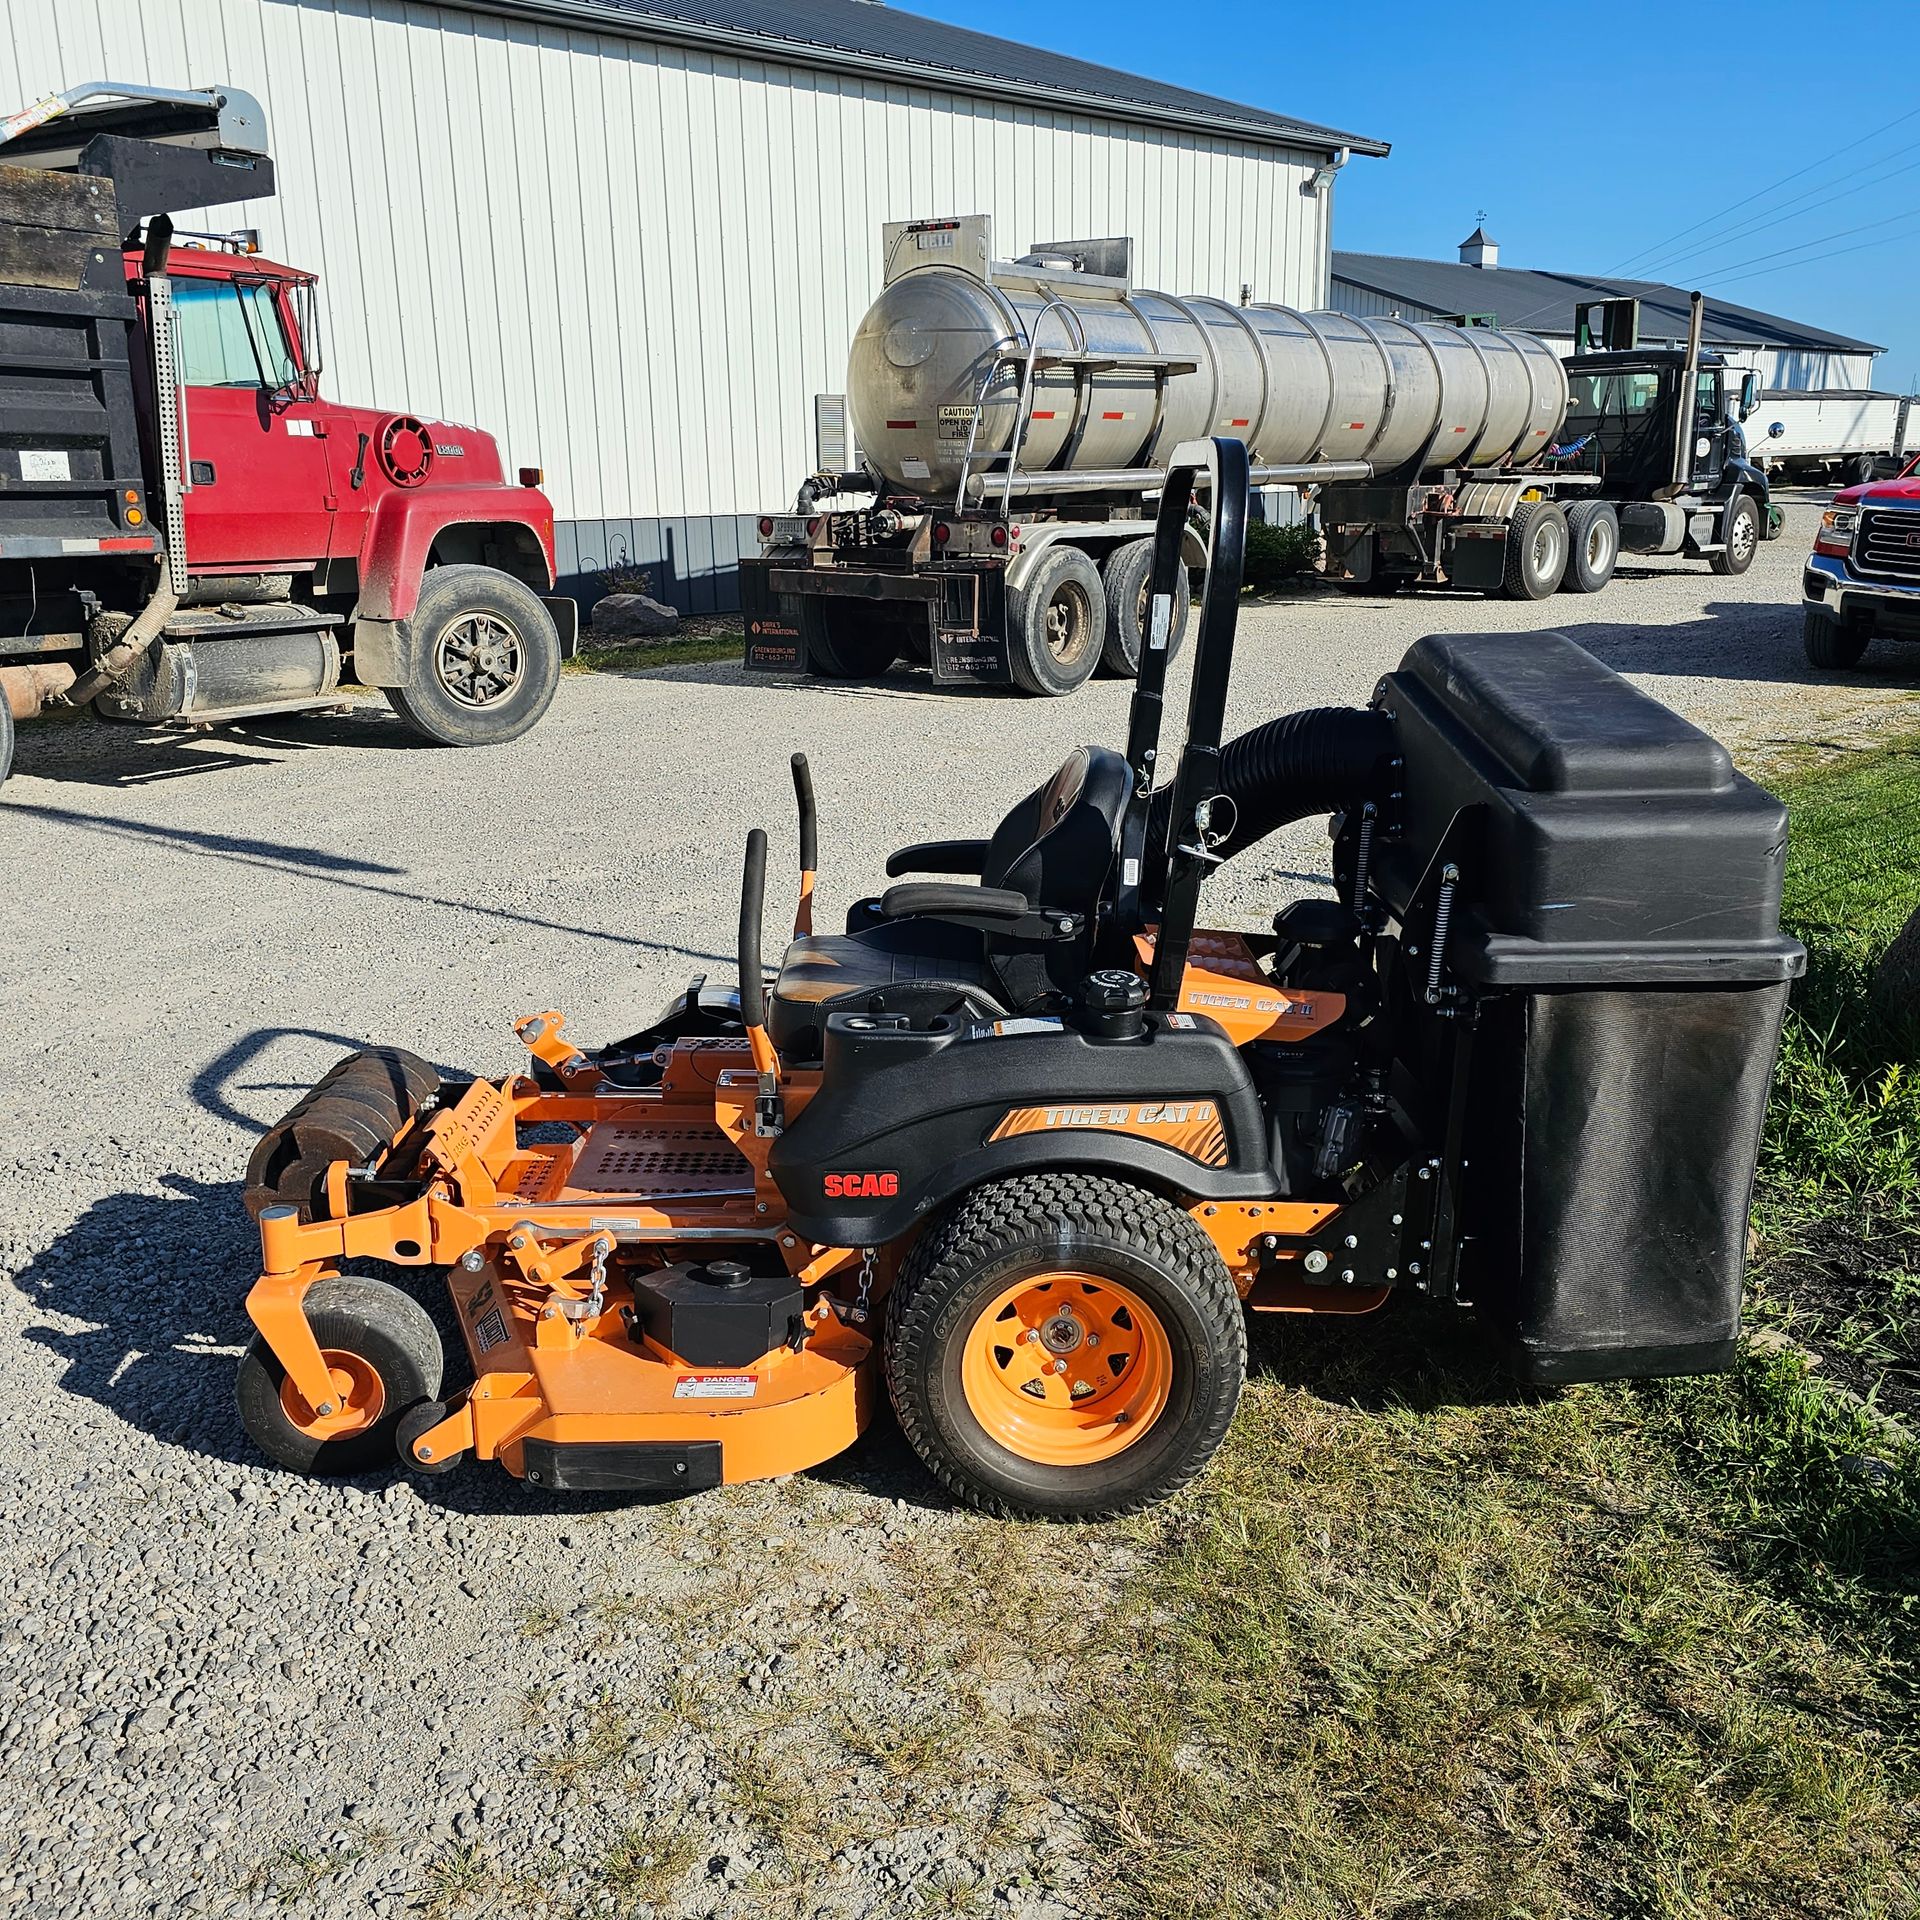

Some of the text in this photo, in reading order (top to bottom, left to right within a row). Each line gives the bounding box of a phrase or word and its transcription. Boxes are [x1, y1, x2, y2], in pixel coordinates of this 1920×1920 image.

[943, 408, 975, 416] CAUTION
[1188, 992, 1251, 1009] TIGER
[1256, 999, 1298, 1014] CAT
[1044, 1104, 1212, 1125] TIGER CAT II
[824, 1174, 898, 1197] SCAG
